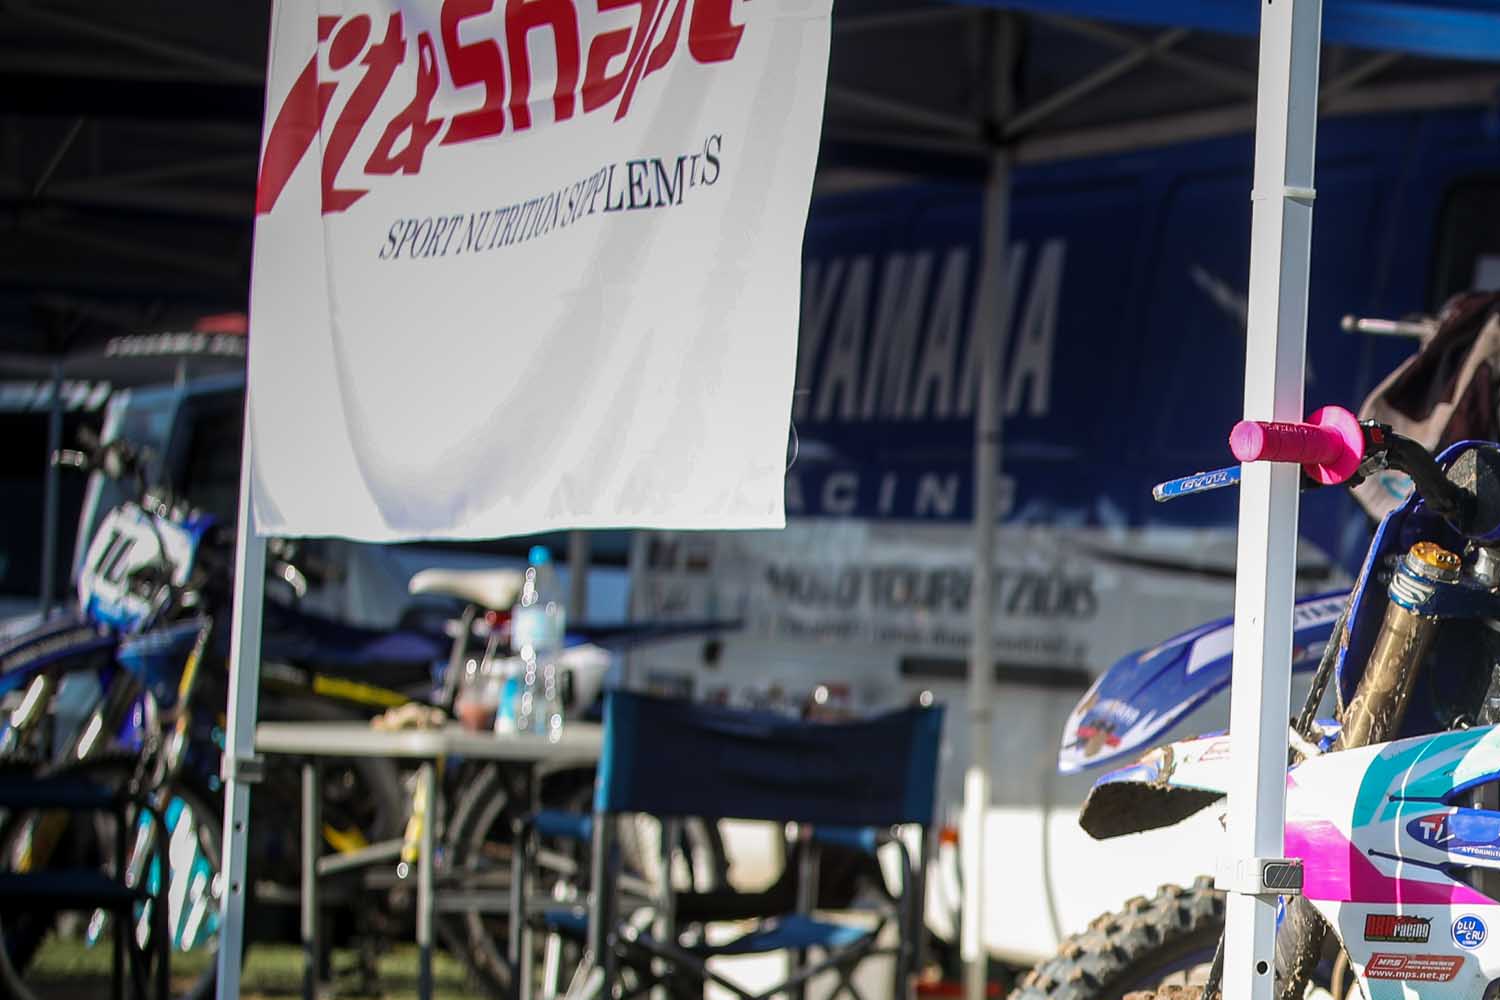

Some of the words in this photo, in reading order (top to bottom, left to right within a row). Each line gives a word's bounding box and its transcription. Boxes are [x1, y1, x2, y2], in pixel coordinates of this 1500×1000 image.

[379, 213, 463, 260] SPORT
[456, 190, 567, 256] NUTRITION
[1368, 969, 1451, 981] www.mps.net.gr
